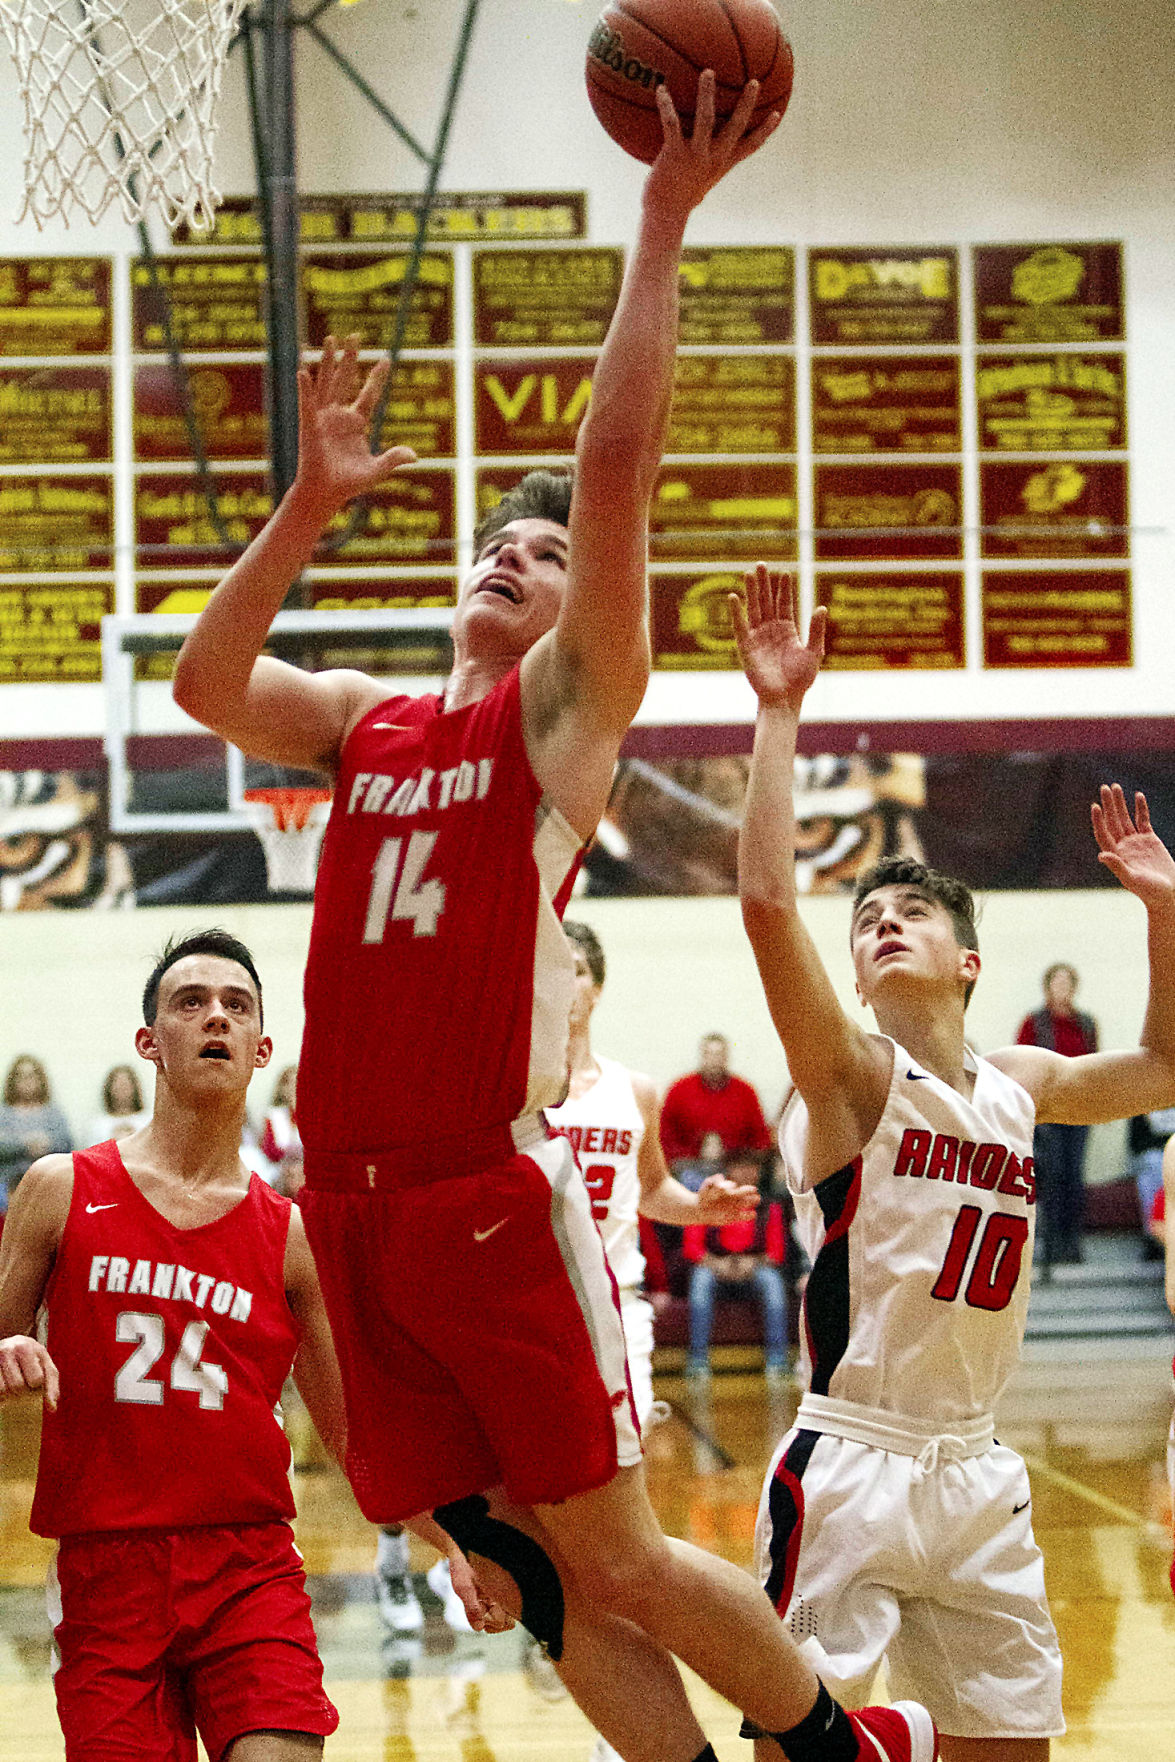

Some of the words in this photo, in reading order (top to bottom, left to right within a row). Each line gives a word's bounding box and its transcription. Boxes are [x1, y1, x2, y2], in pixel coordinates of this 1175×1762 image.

[362, 829, 447, 945] 14
[88, 1255, 253, 1324] FRANKTON
[930, 1204, 1029, 1312] 10
[114, 1310, 229, 1411] 24
